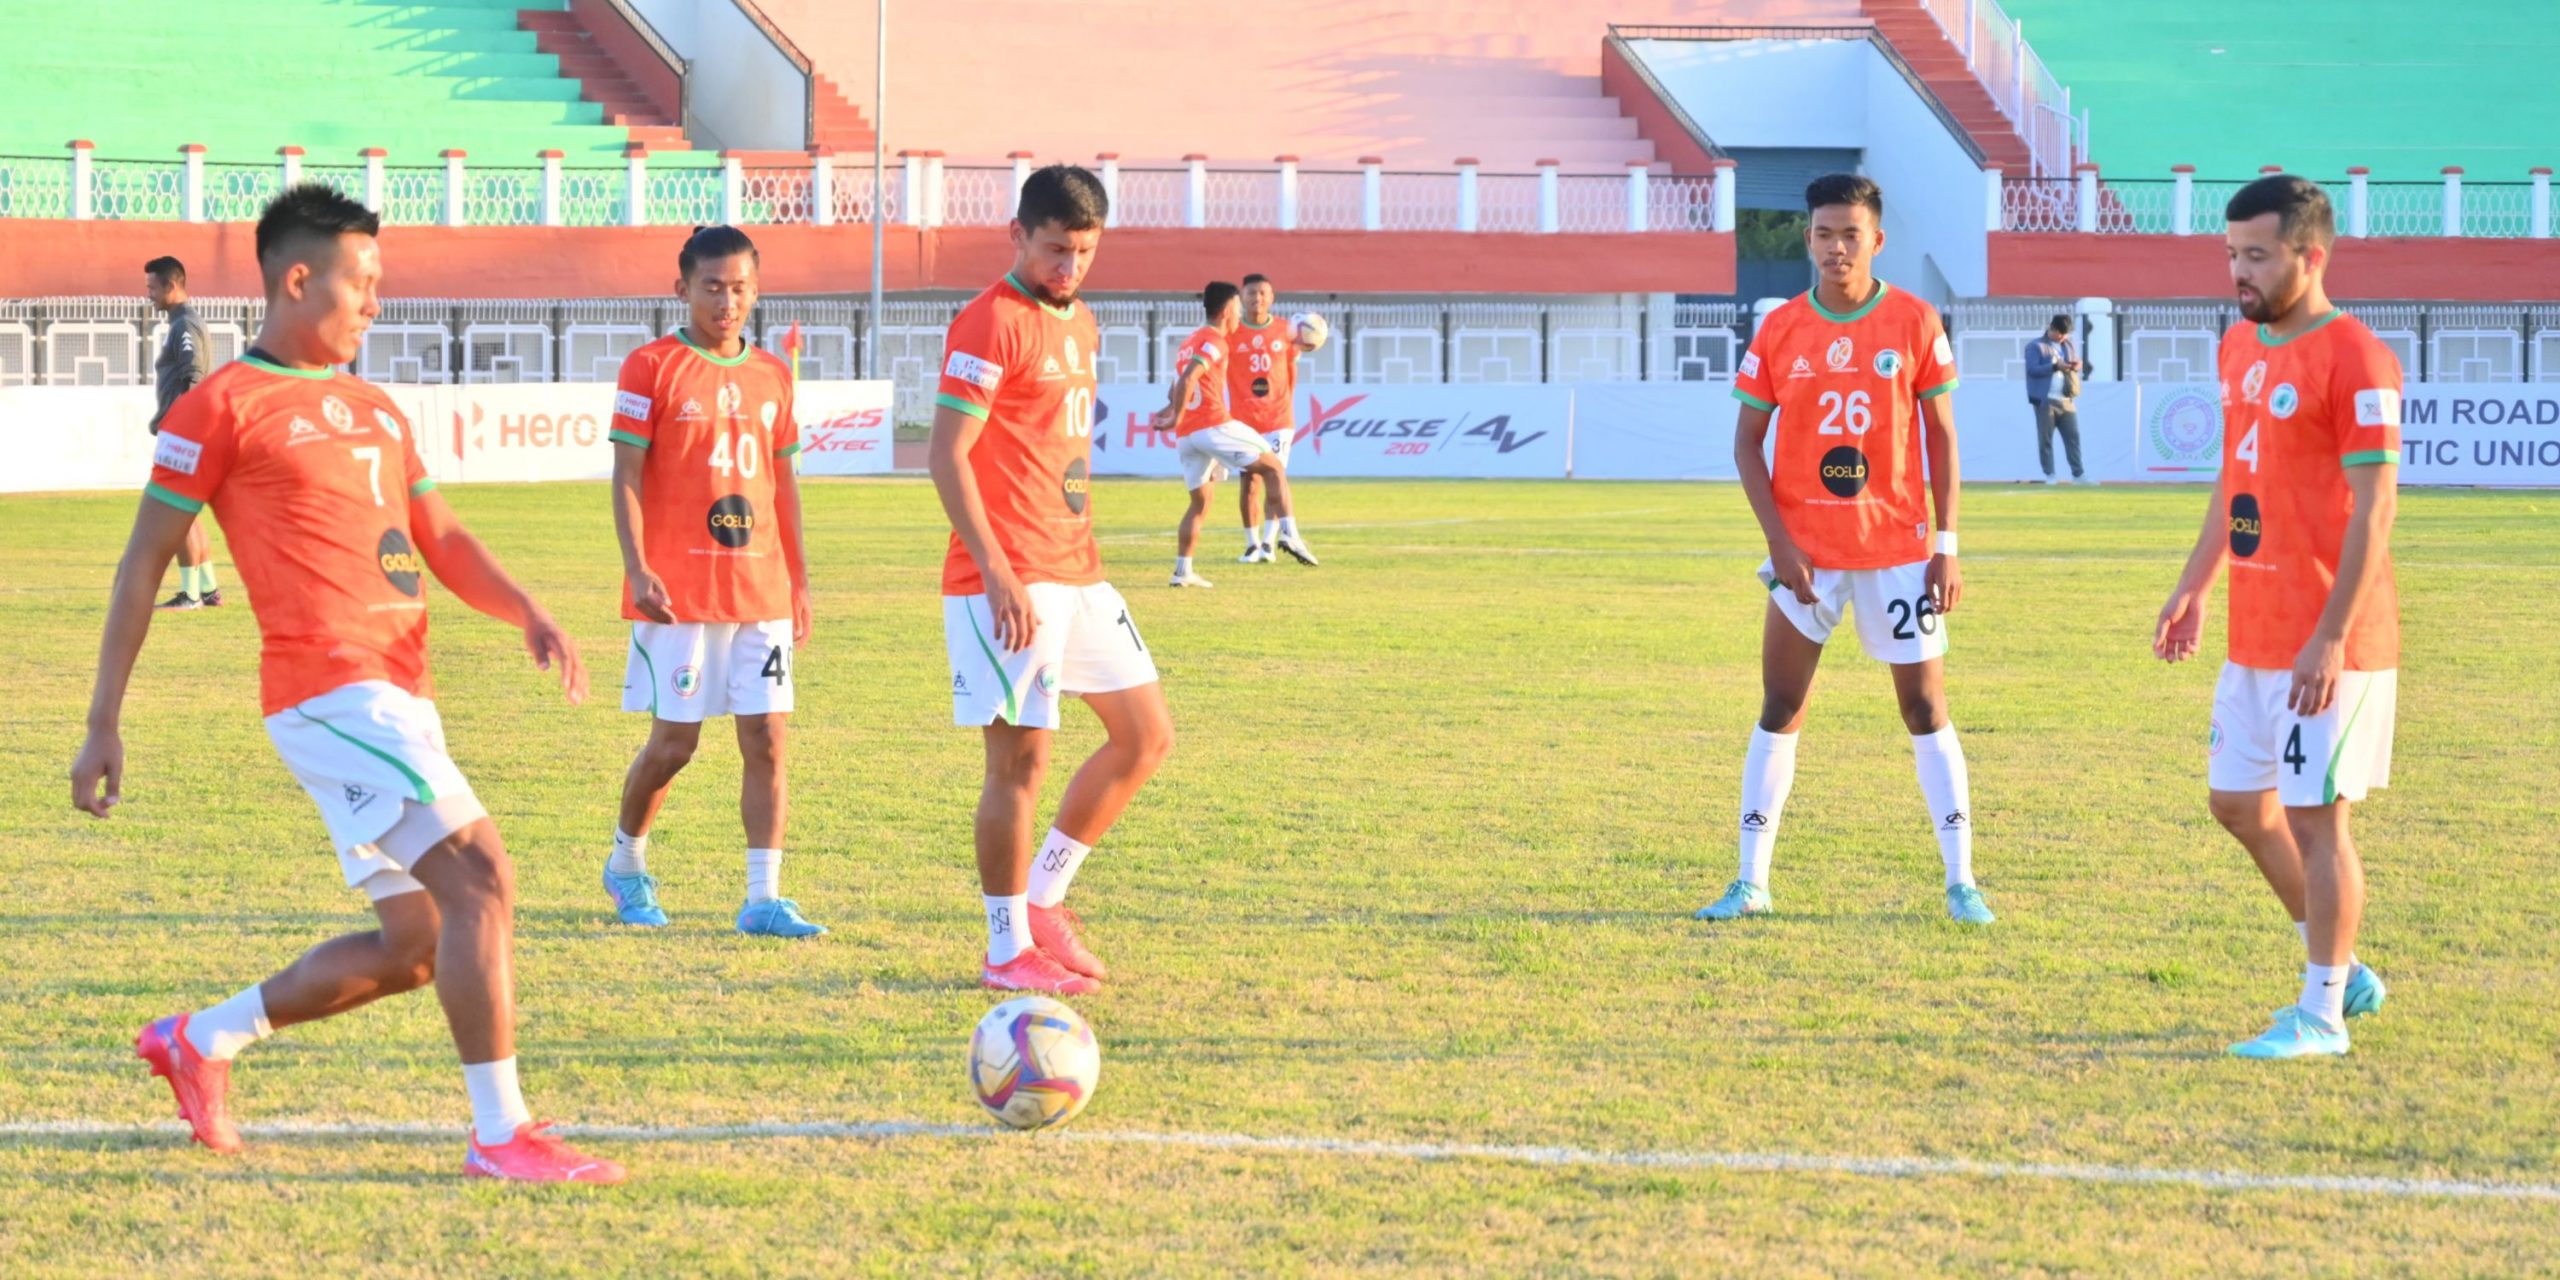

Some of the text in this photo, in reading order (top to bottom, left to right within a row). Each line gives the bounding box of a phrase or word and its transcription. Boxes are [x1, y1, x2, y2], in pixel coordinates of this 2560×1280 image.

[1249, 353, 1272, 373] 30
[500, 413, 597, 447] Hero
[1064, 387, 1092, 437] 10
[1291, 392, 1447, 456] XPULSE
[1818, 390, 1872, 436] 26
[2453, 399, 2560, 425] ROAD
[709, 432, 758, 479] 40
[1384, 442, 1429, 456] 200
[2235, 420, 2259, 473] 4
[2402, 440, 2560, 466] TIC UNIO
[352, 446, 385, 506] 7
[1887, 594, 1937, 640] 26
[761, 645, 793, 686] 4
[2283, 723, 2307, 775] 4
